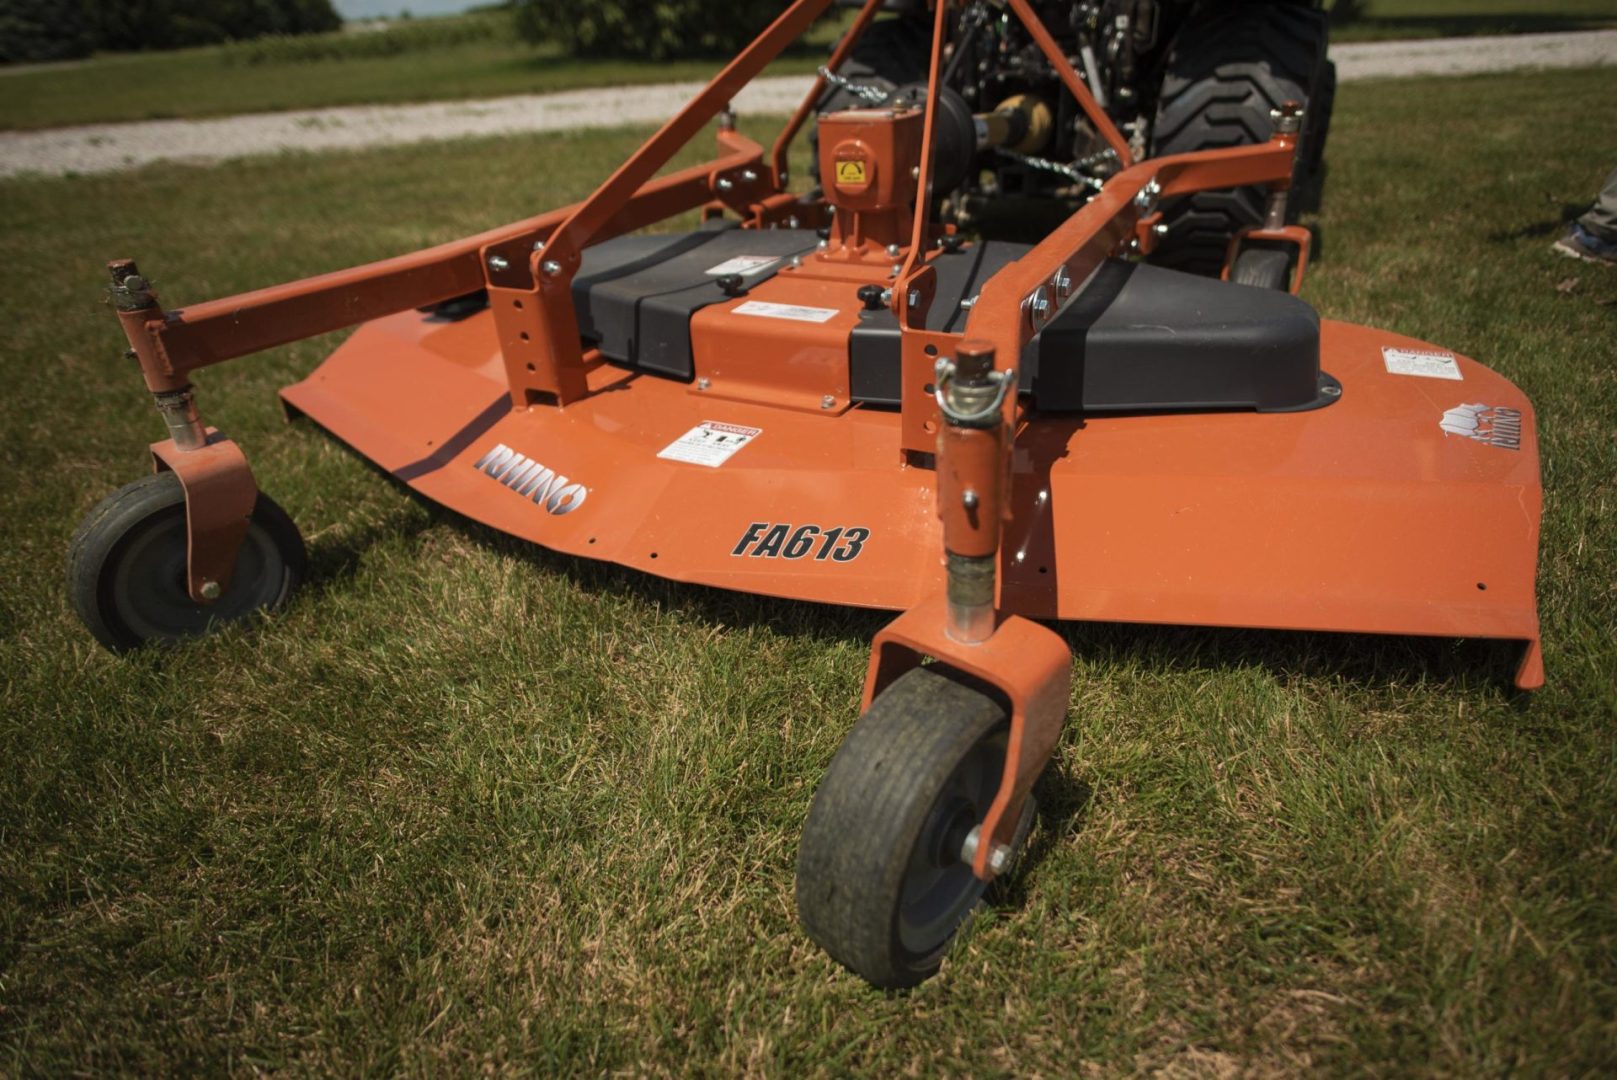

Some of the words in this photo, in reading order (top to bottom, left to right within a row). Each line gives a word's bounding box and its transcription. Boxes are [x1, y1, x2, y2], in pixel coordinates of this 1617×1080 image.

[712, 423, 758, 436] DANGER
[473, 443, 588, 516] RHINO
[730, 522, 871, 562] FA613
